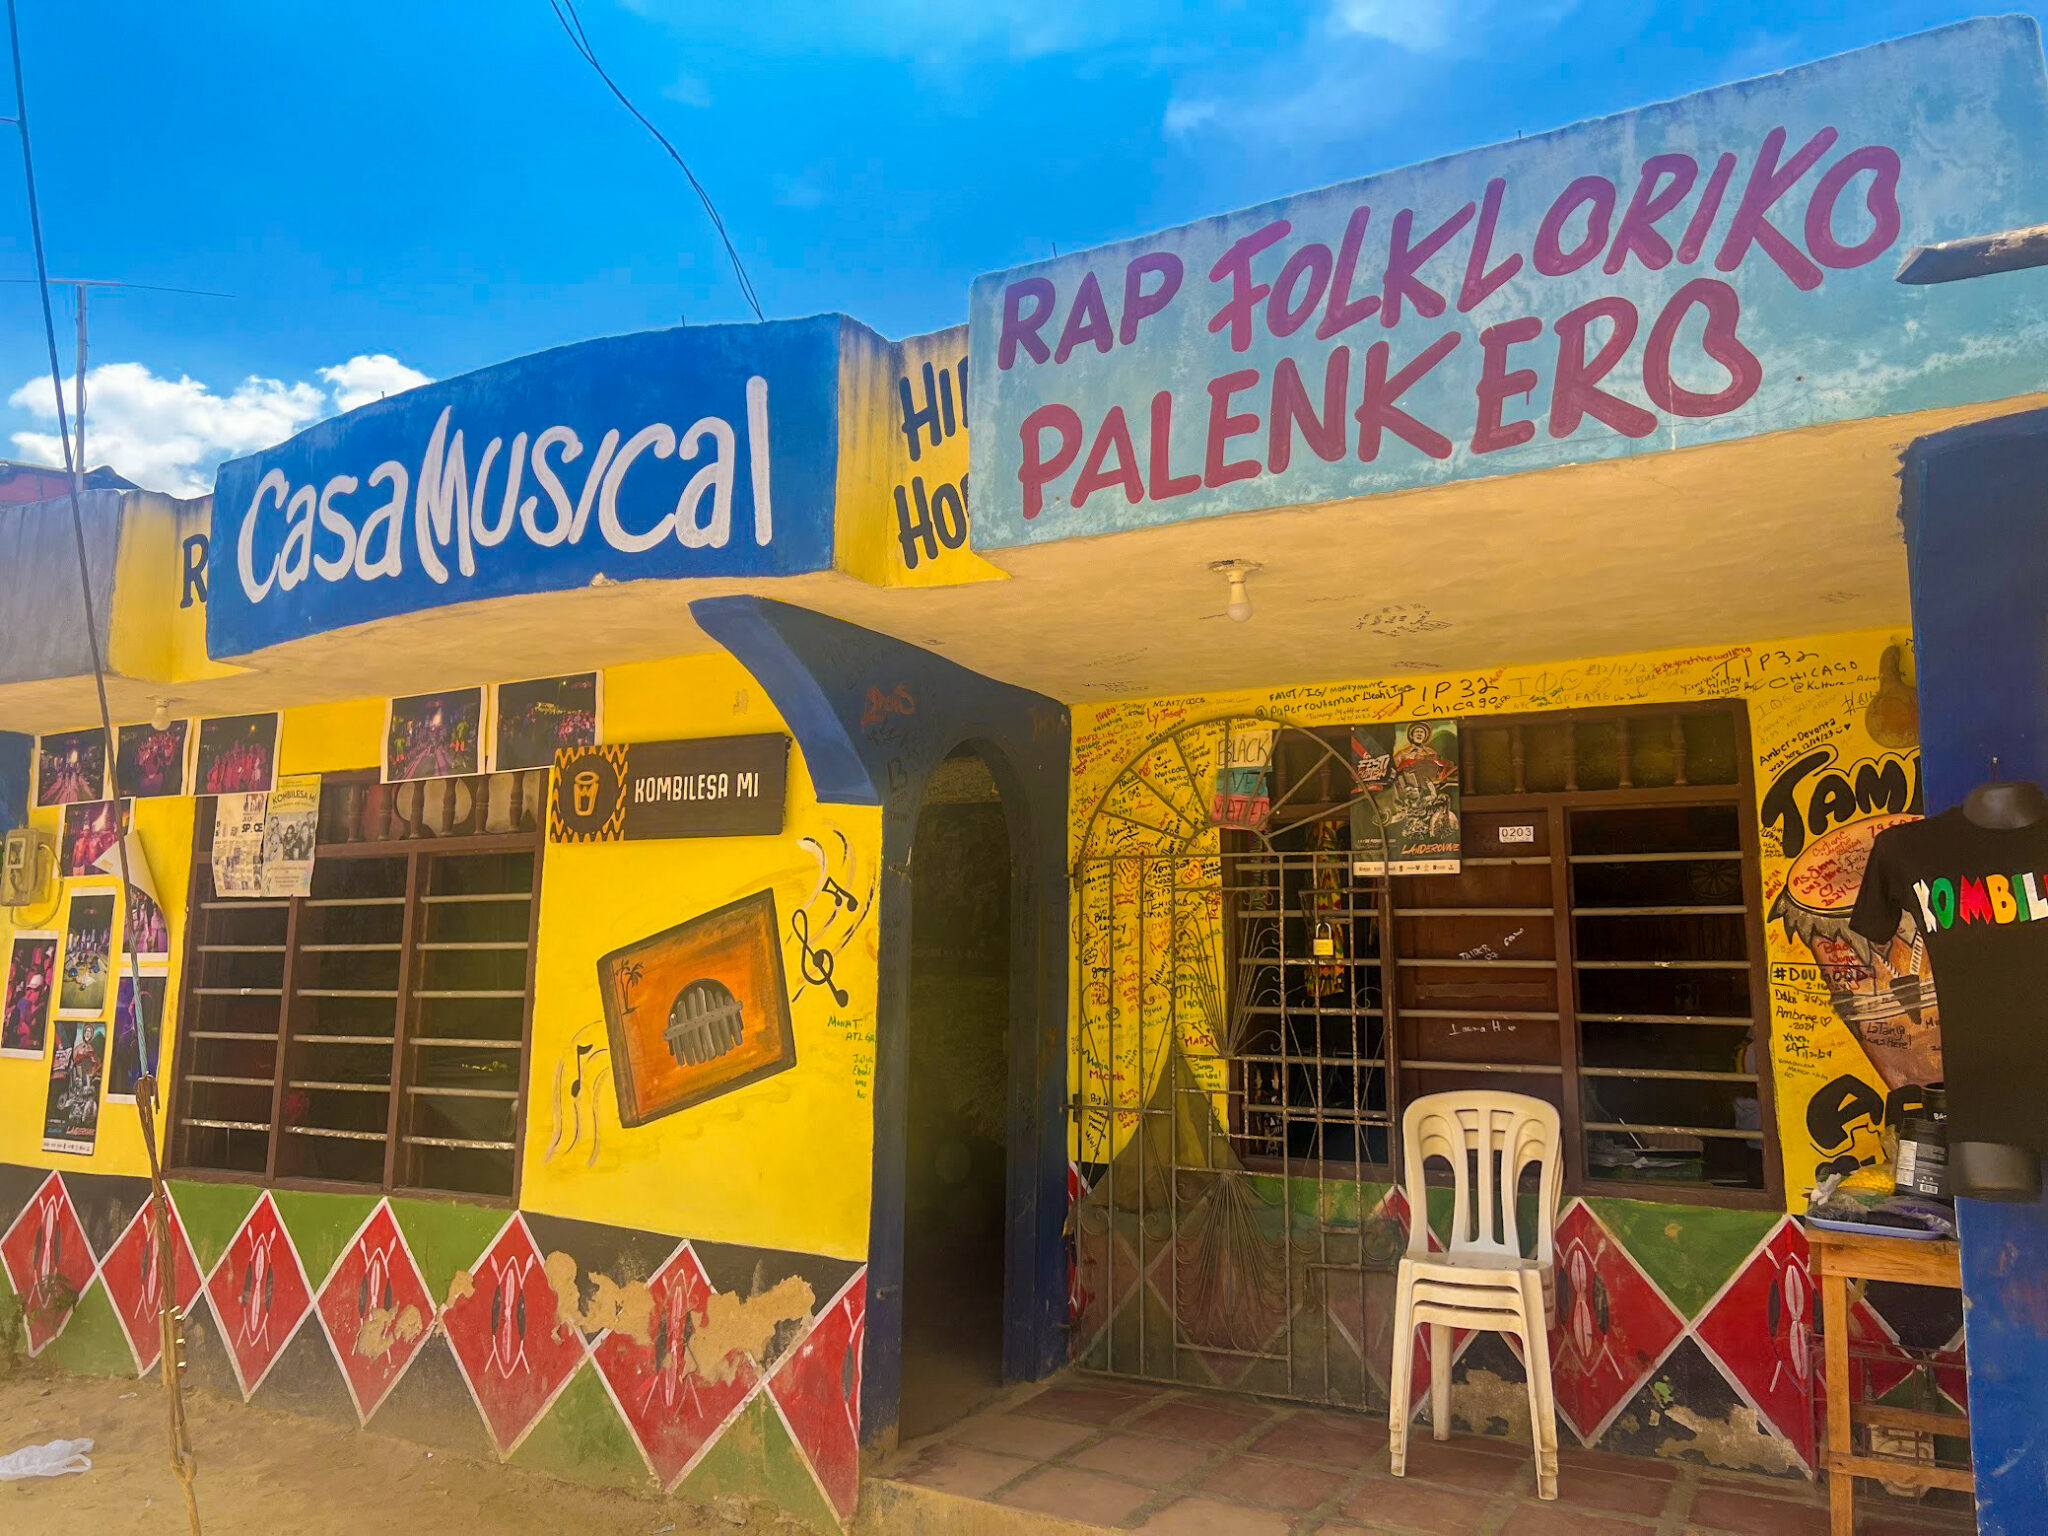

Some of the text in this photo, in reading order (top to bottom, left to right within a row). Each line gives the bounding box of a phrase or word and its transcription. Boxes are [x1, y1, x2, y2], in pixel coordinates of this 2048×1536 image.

[998, 126, 1901, 370] RAP FOLKLORIKO
[1018, 277, 1763, 520] PALENKERO
[237, 467, 408, 603] Casa
[1768, 660, 1857, 689] CHICAGO
[1411, 696, 1498, 717] Chicago
[1760, 739, 1791, 766] Amber
[635, 772, 759, 803] KOMBILESA MI
[1501, 826, 1532, 838] 0203
[1912, 871, 2048, 934] KOMBIL
